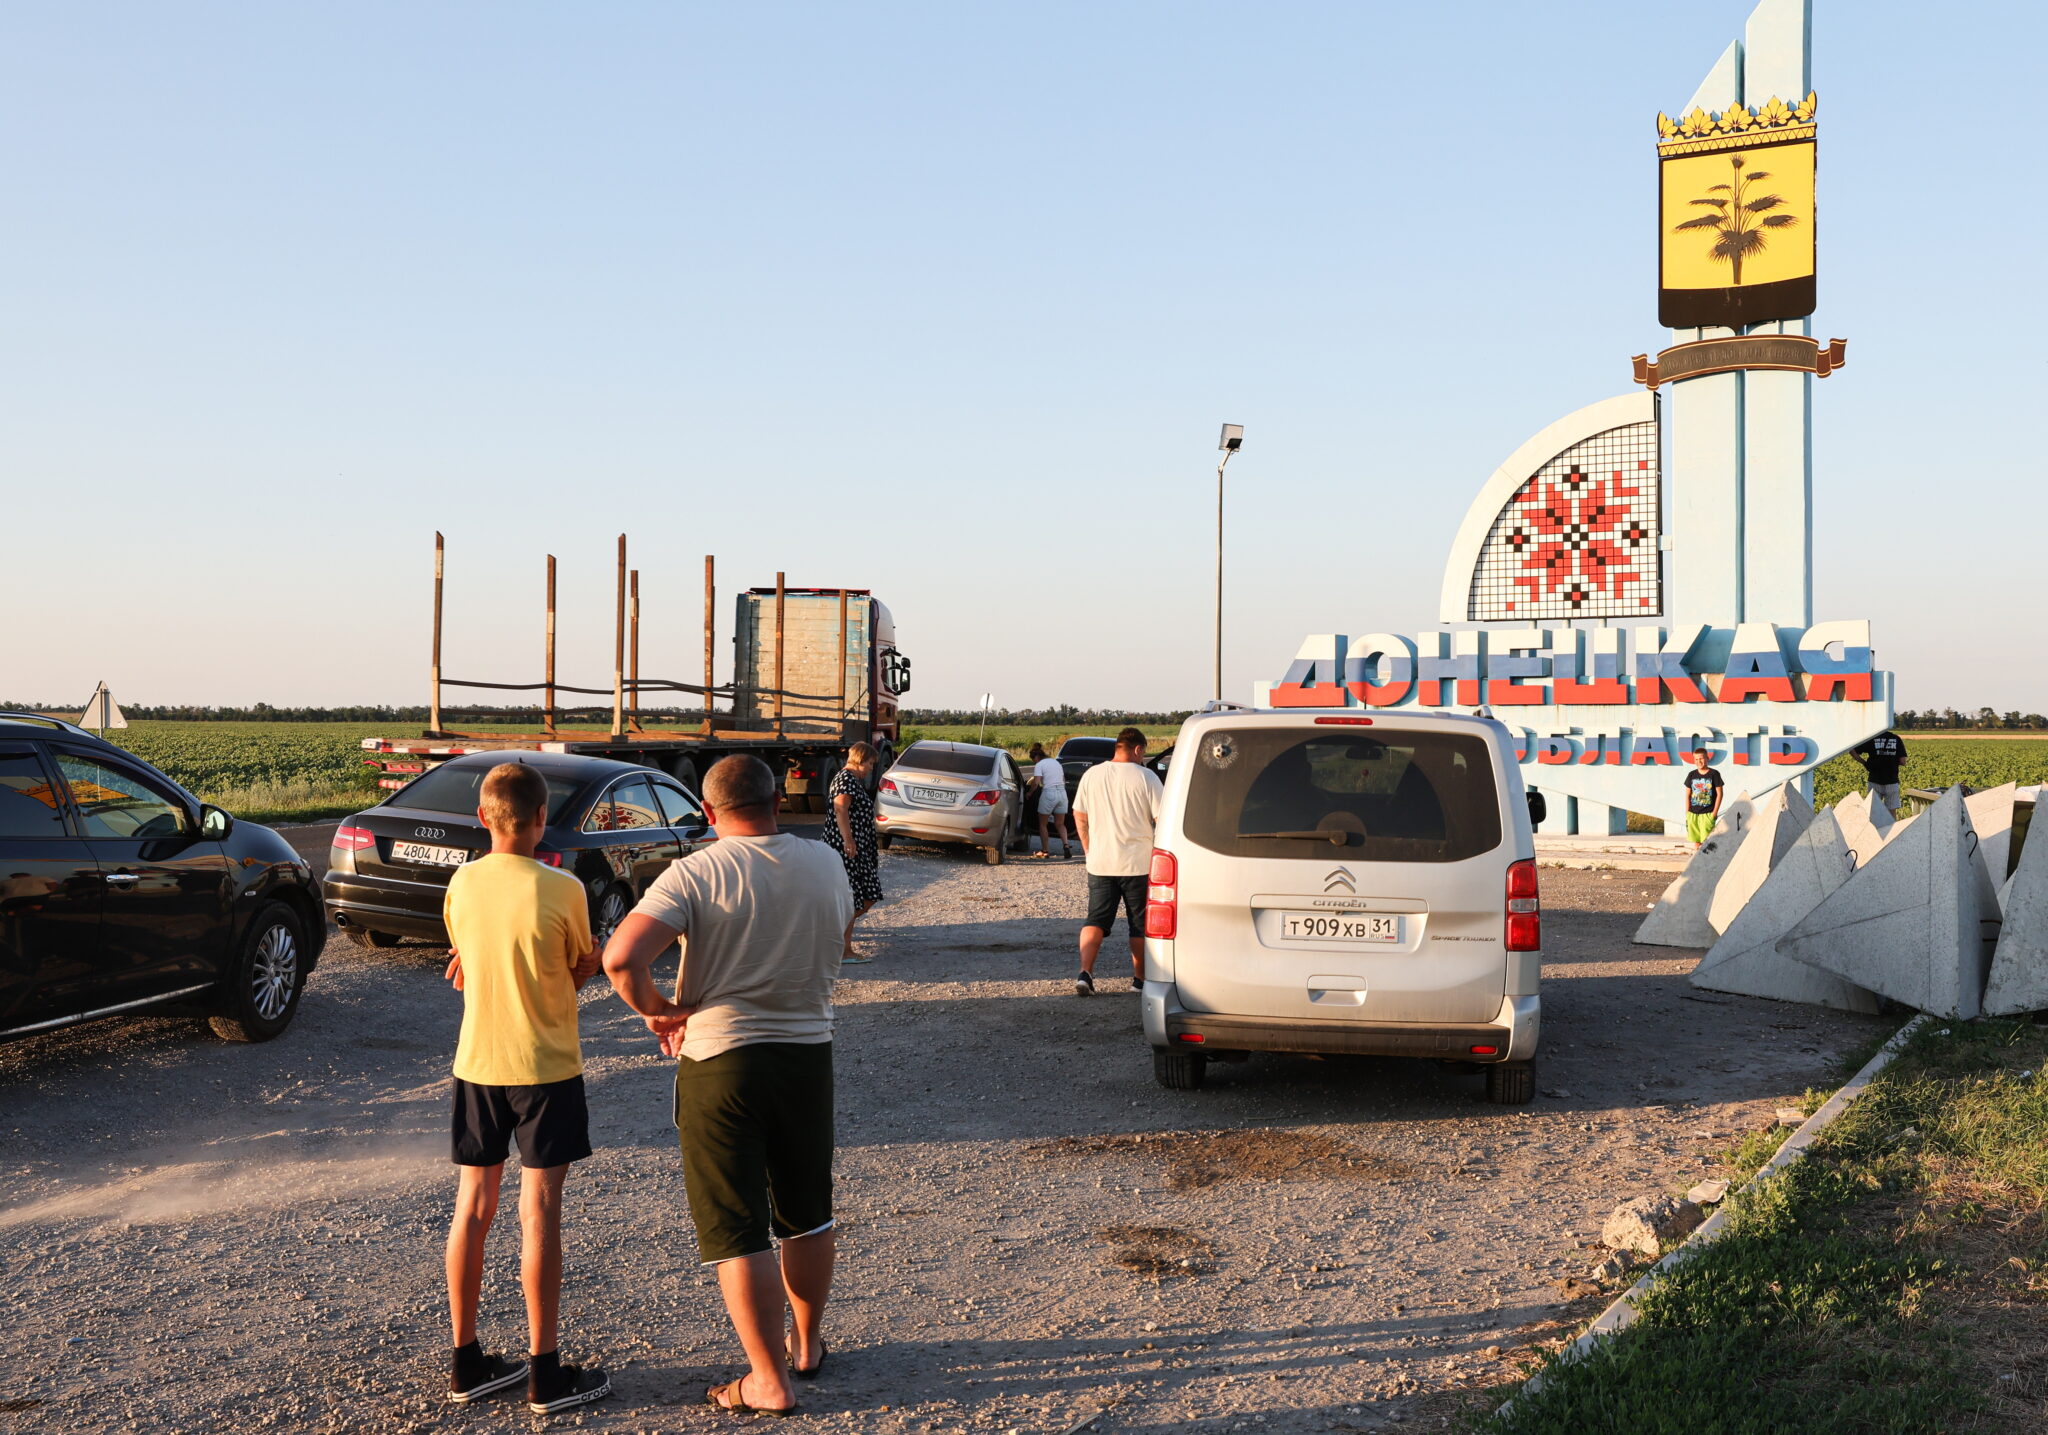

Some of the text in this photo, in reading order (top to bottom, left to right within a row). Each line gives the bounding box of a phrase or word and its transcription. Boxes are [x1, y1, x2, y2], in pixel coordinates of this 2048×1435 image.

[1270, 620, 1874, 707] ДОНЕЦКАЯ
[403, 845, 430, 860] 4804
[1372, 918, 1391, 933] 31
[581, 1384, 610, 1401] crocs
